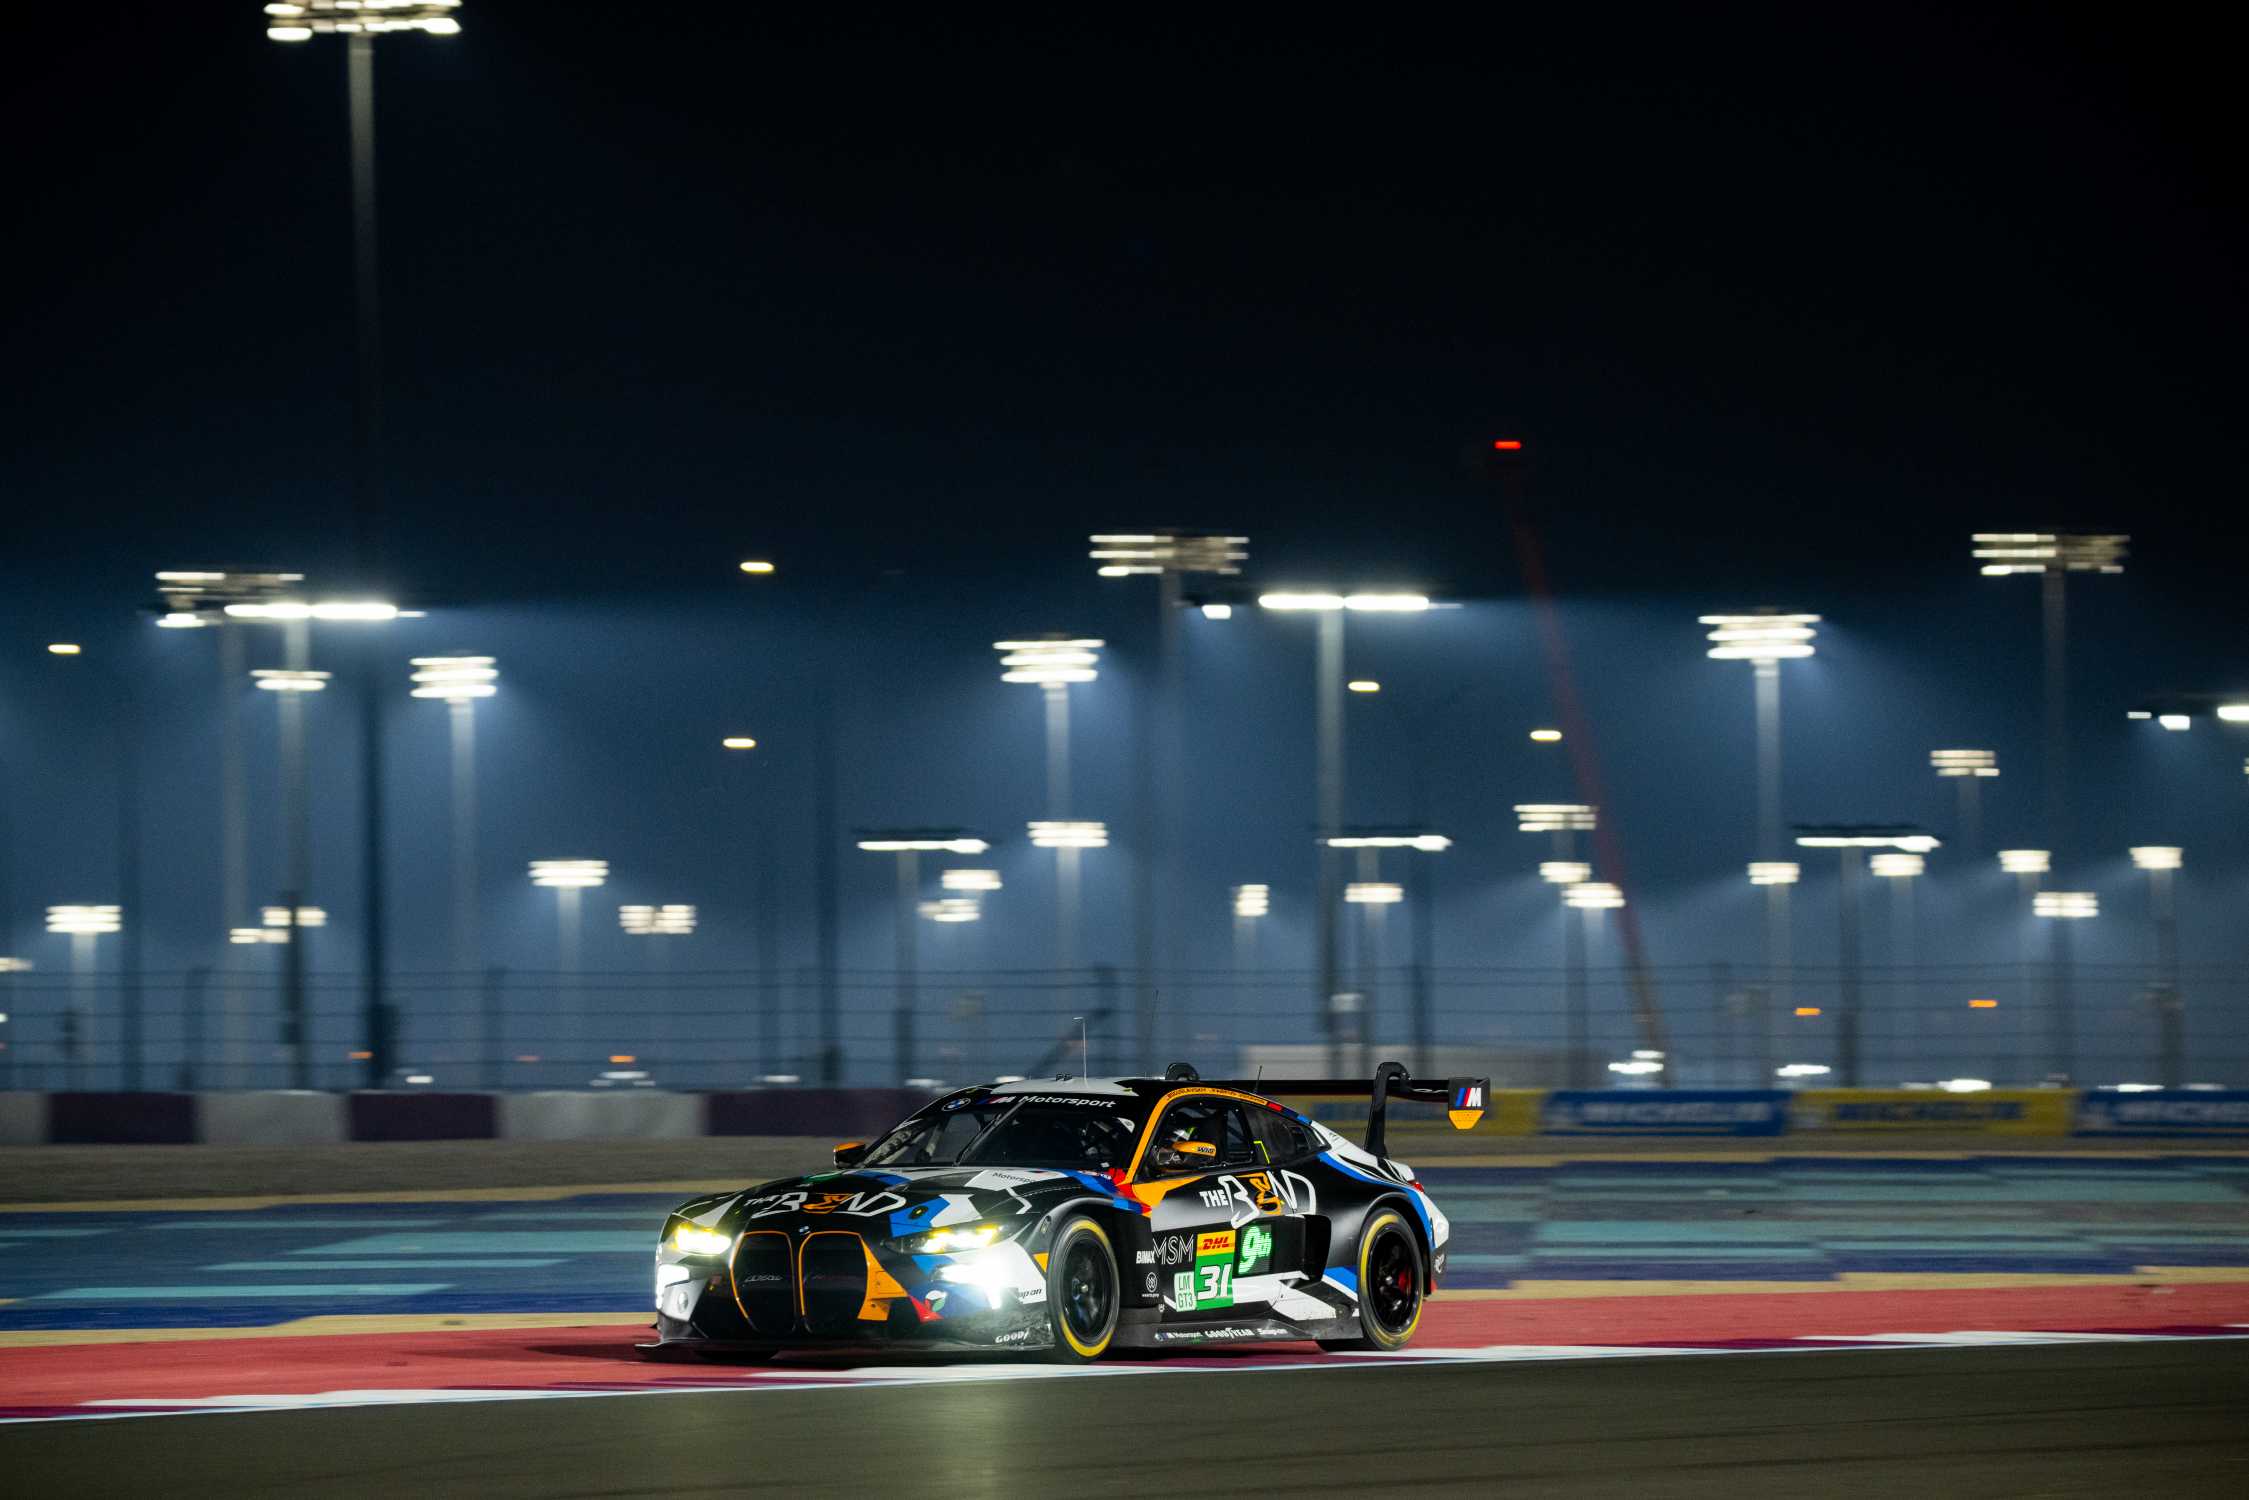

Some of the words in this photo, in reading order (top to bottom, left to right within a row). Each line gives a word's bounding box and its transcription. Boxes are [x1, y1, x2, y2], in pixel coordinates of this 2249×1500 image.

[1017, 1096, 1113, 1108] Motorsport
[1198, 1189, 1230, 1209] THE
[1217, 1169, 1316, 1229] BEND
[1152, 1234, 1194, 1265] MSM
[1201, 1236, 1230, 1250] DHL
[1238, 1226, 1272, 1275] 9th
[1178, 1275, 1192, 1291] LM
[1197, 1263, 1232, 1301] 31
[1178, 1291, 1194, 1309] GT3
[1204, 1327, 1255, 1339] GOODYEAR
